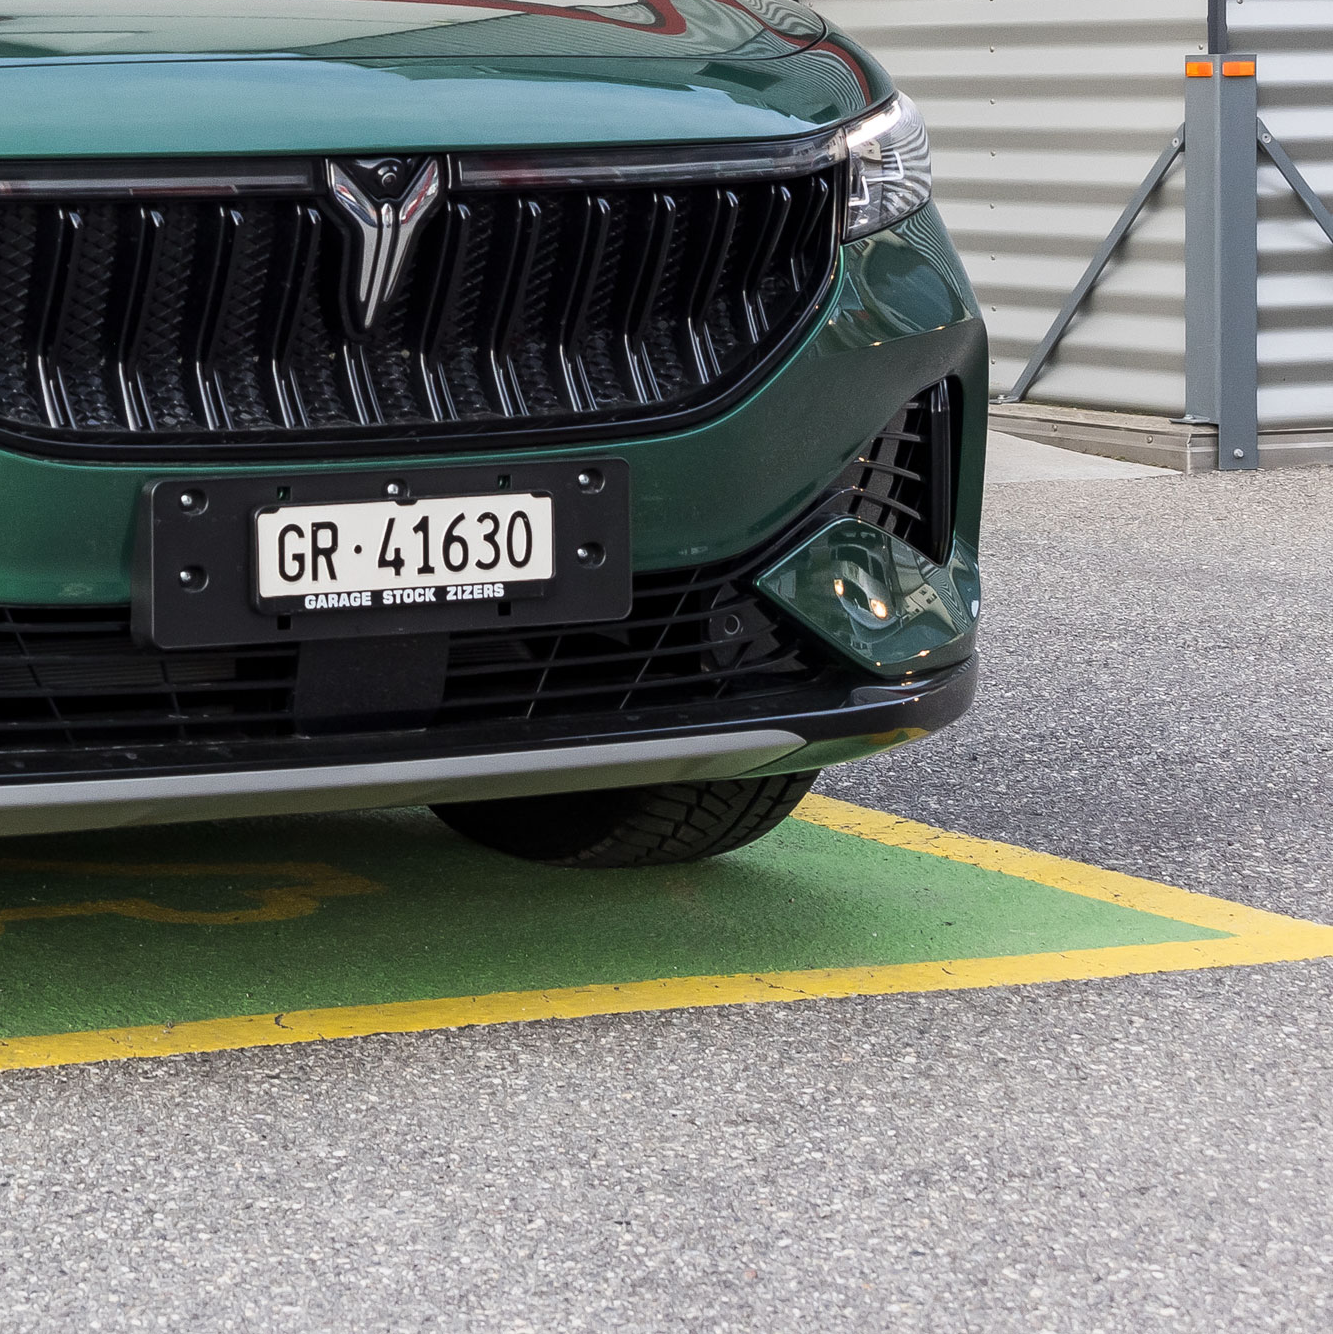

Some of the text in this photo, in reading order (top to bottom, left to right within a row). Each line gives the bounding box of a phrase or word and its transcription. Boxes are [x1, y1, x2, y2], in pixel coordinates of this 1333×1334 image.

[304, 582, 505, 610] GARAGE STOCK ZIZERS
